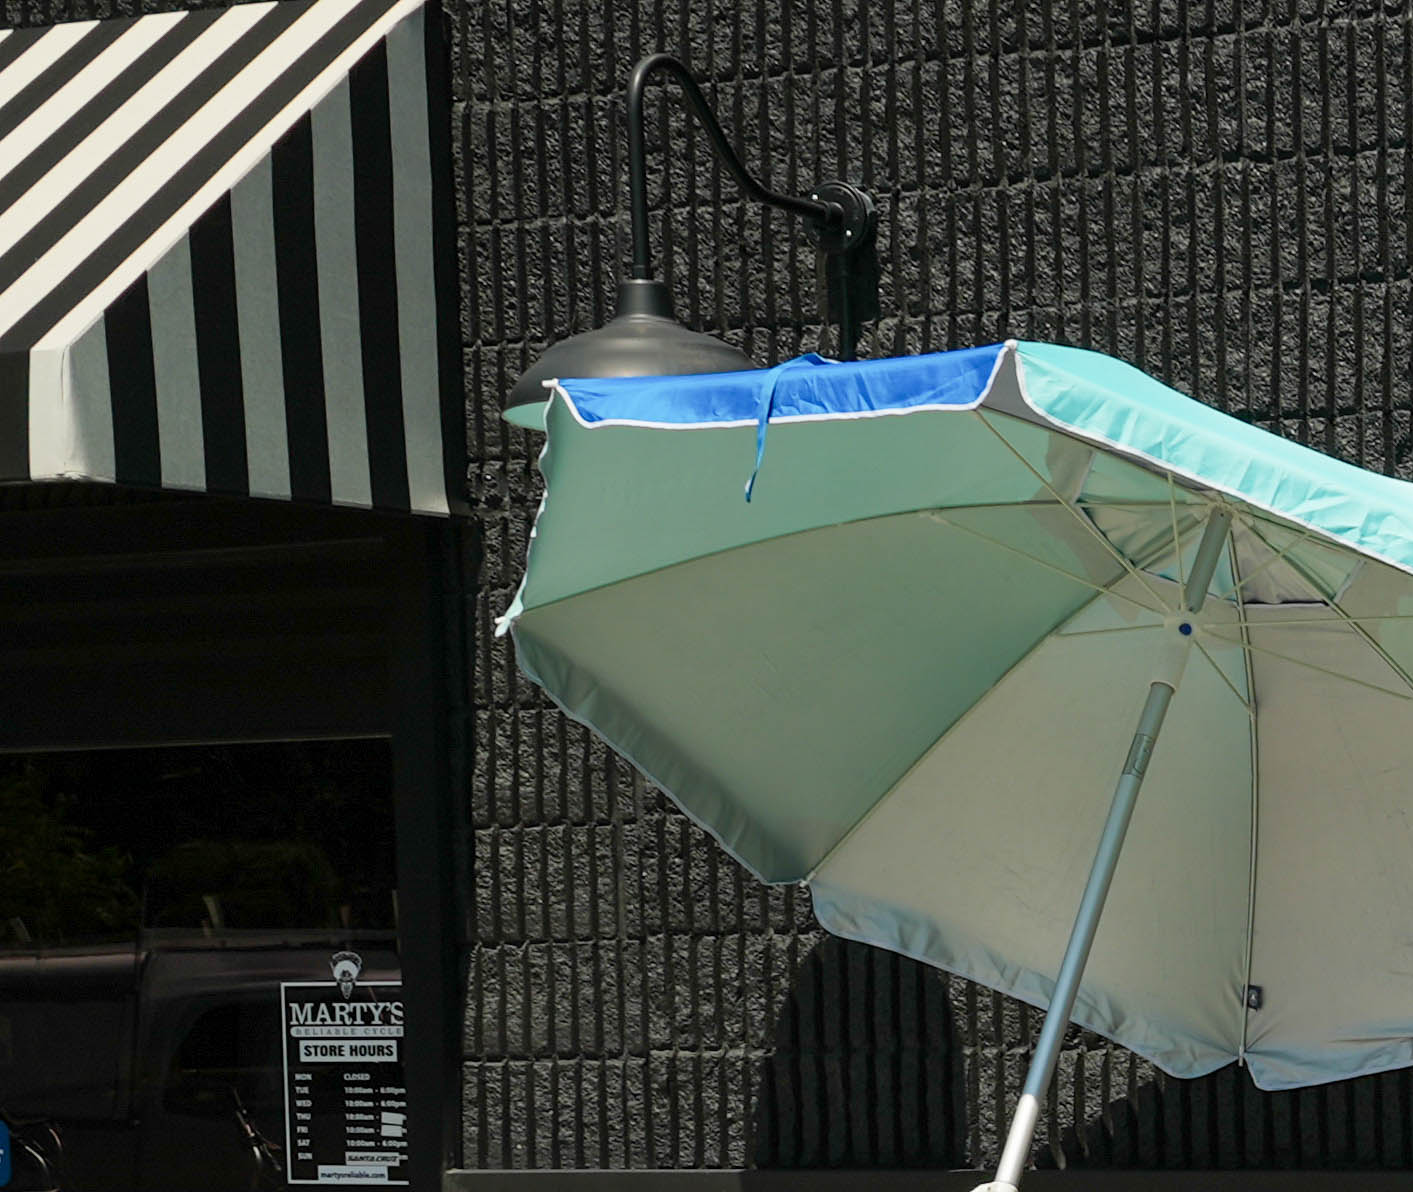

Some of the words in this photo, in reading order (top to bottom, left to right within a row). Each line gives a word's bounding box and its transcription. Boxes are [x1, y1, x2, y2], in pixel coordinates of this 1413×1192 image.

[289, 1001, 404, 1026] MARTY'S
[295, 1027, 355, 1036] RELIABLE
[363, 1027, 404, 1036] CYCLE
[303, 1044, 346, 1057] STORE
[349, 1044, 394, 1057] HOURS
[343, 1073, 371, 1081] CLOSED
[297, 1139, 310, 1147] SAT
